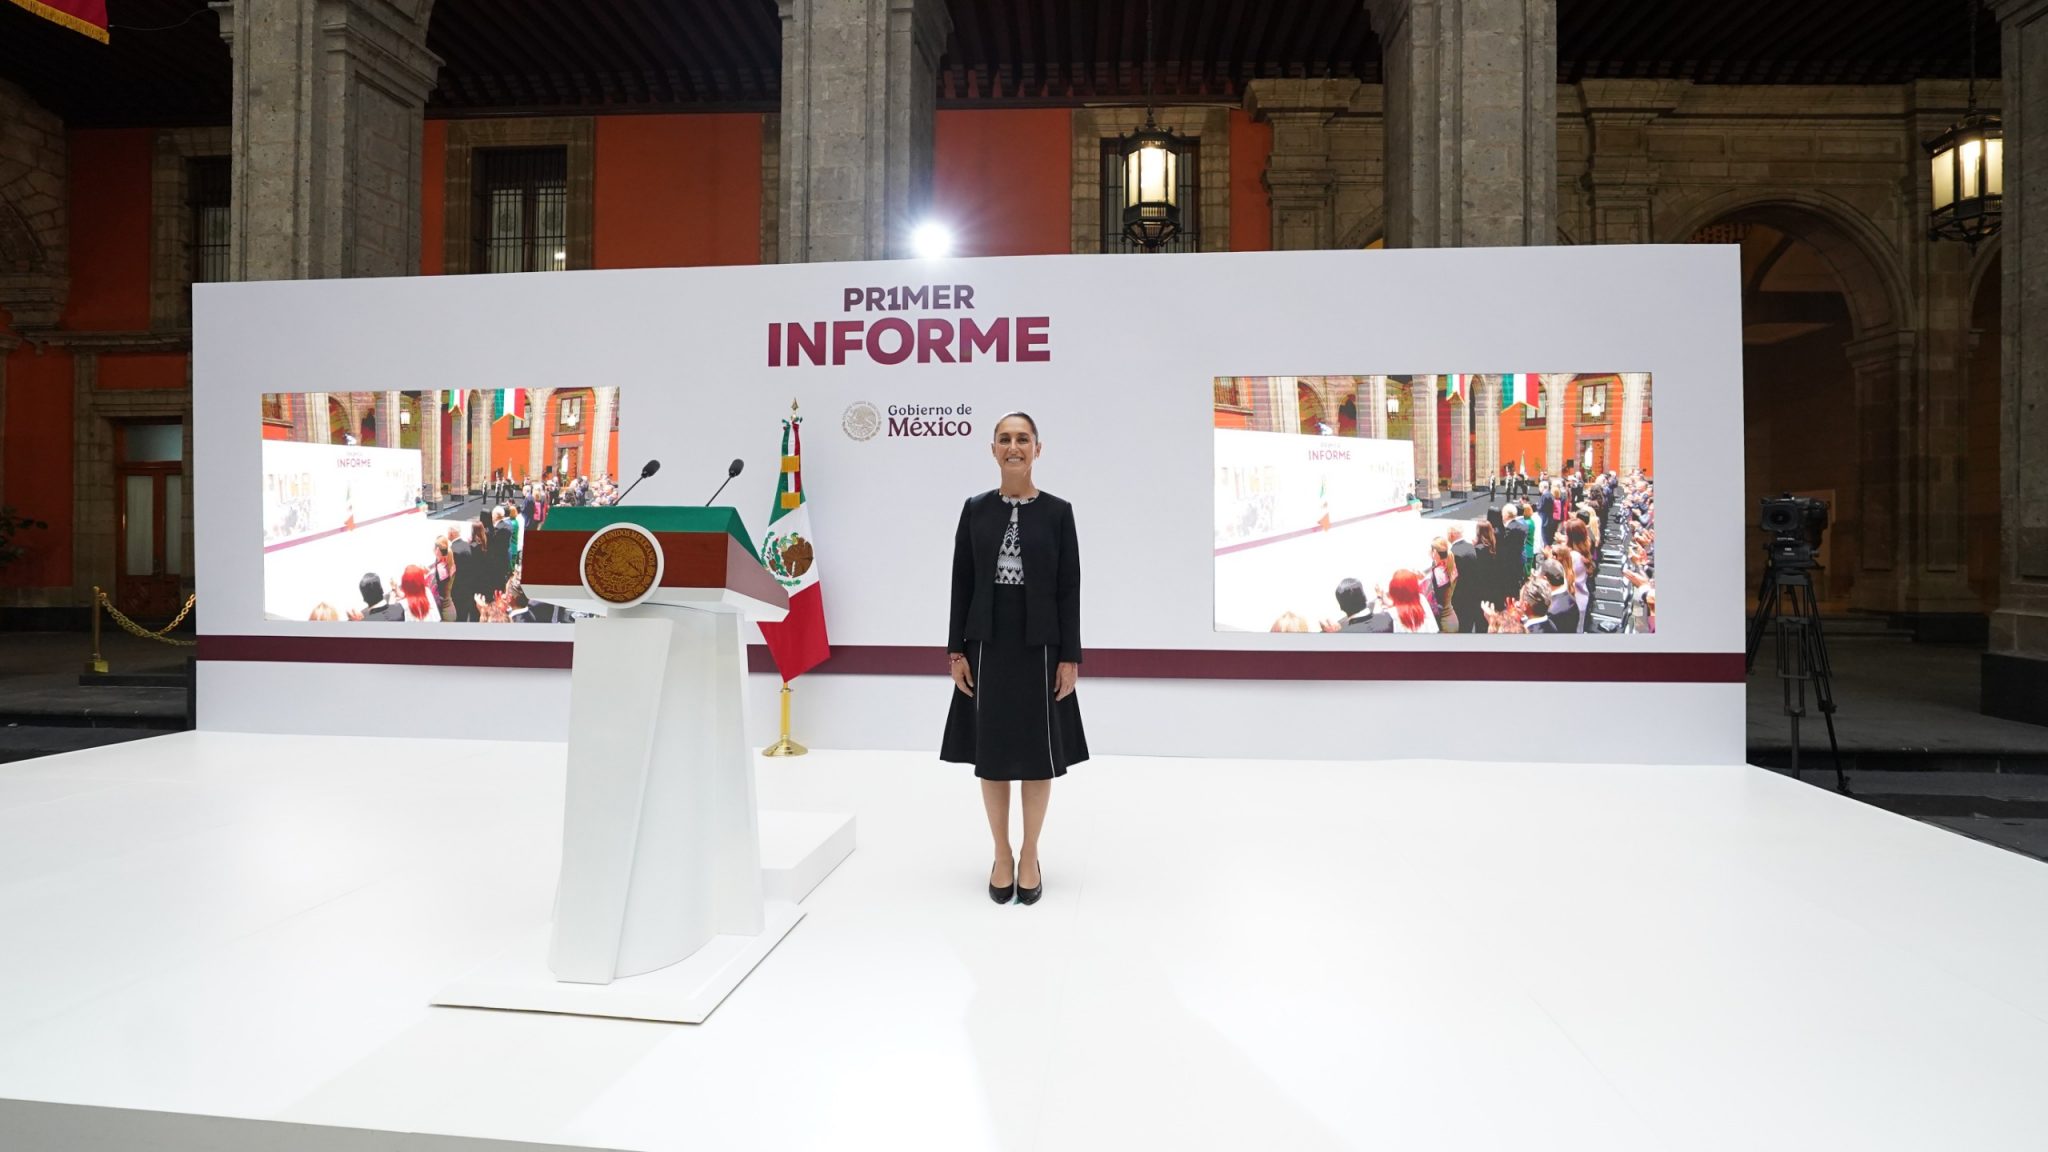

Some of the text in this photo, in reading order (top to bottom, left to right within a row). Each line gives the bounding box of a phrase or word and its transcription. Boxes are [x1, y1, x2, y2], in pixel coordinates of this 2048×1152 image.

[843, 284, 975, 312] PR1MER
[768, 316, 1051, 367] INFORME
[888, 404, 972, 416] Gobierno de
[887, 416, 972, 437] México
[1308, 449, 1351, 460] INFORME
[337, 457, 372, 468] INFORME
[605, 530, 630, 540] UNIDOS
